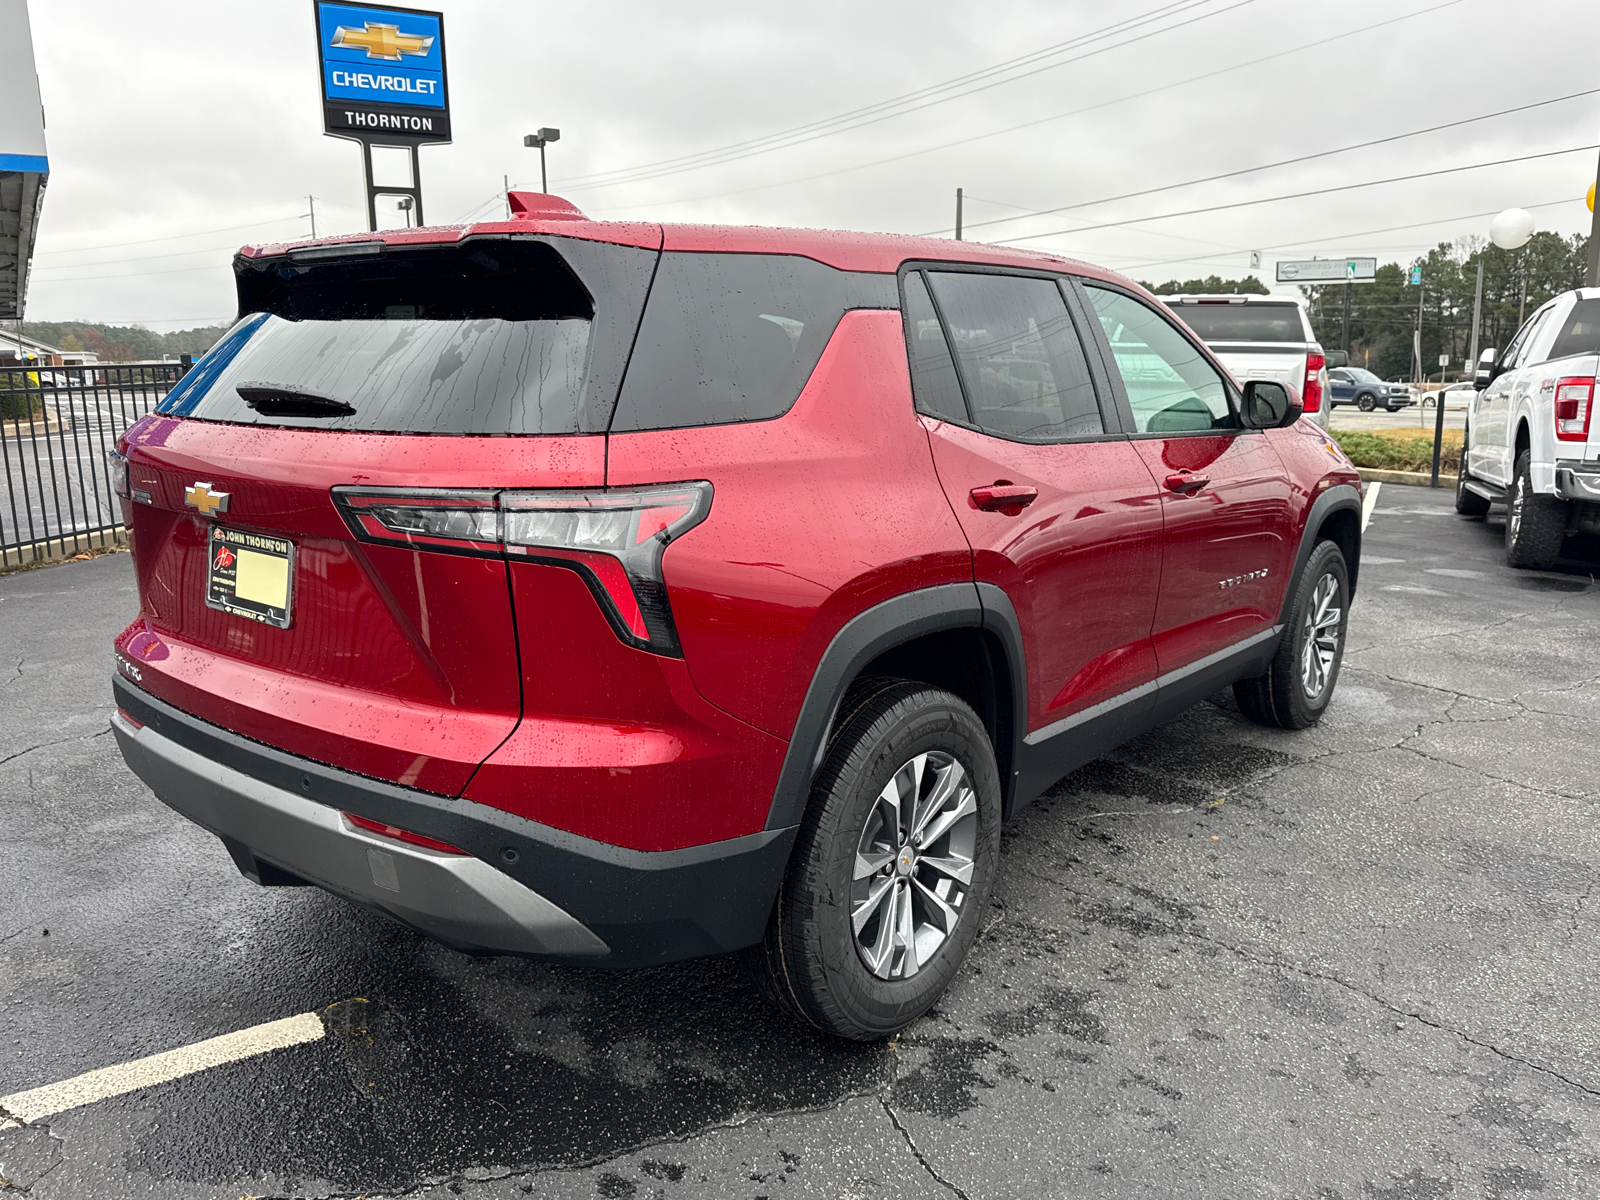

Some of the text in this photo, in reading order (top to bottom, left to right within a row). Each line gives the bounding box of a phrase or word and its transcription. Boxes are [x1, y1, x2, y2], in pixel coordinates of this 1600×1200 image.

[332, 71, 437, 94] CHEVROLET
[344, 111, 433, 131] THORNTON
[226, 530, 246, 545] JOHN
